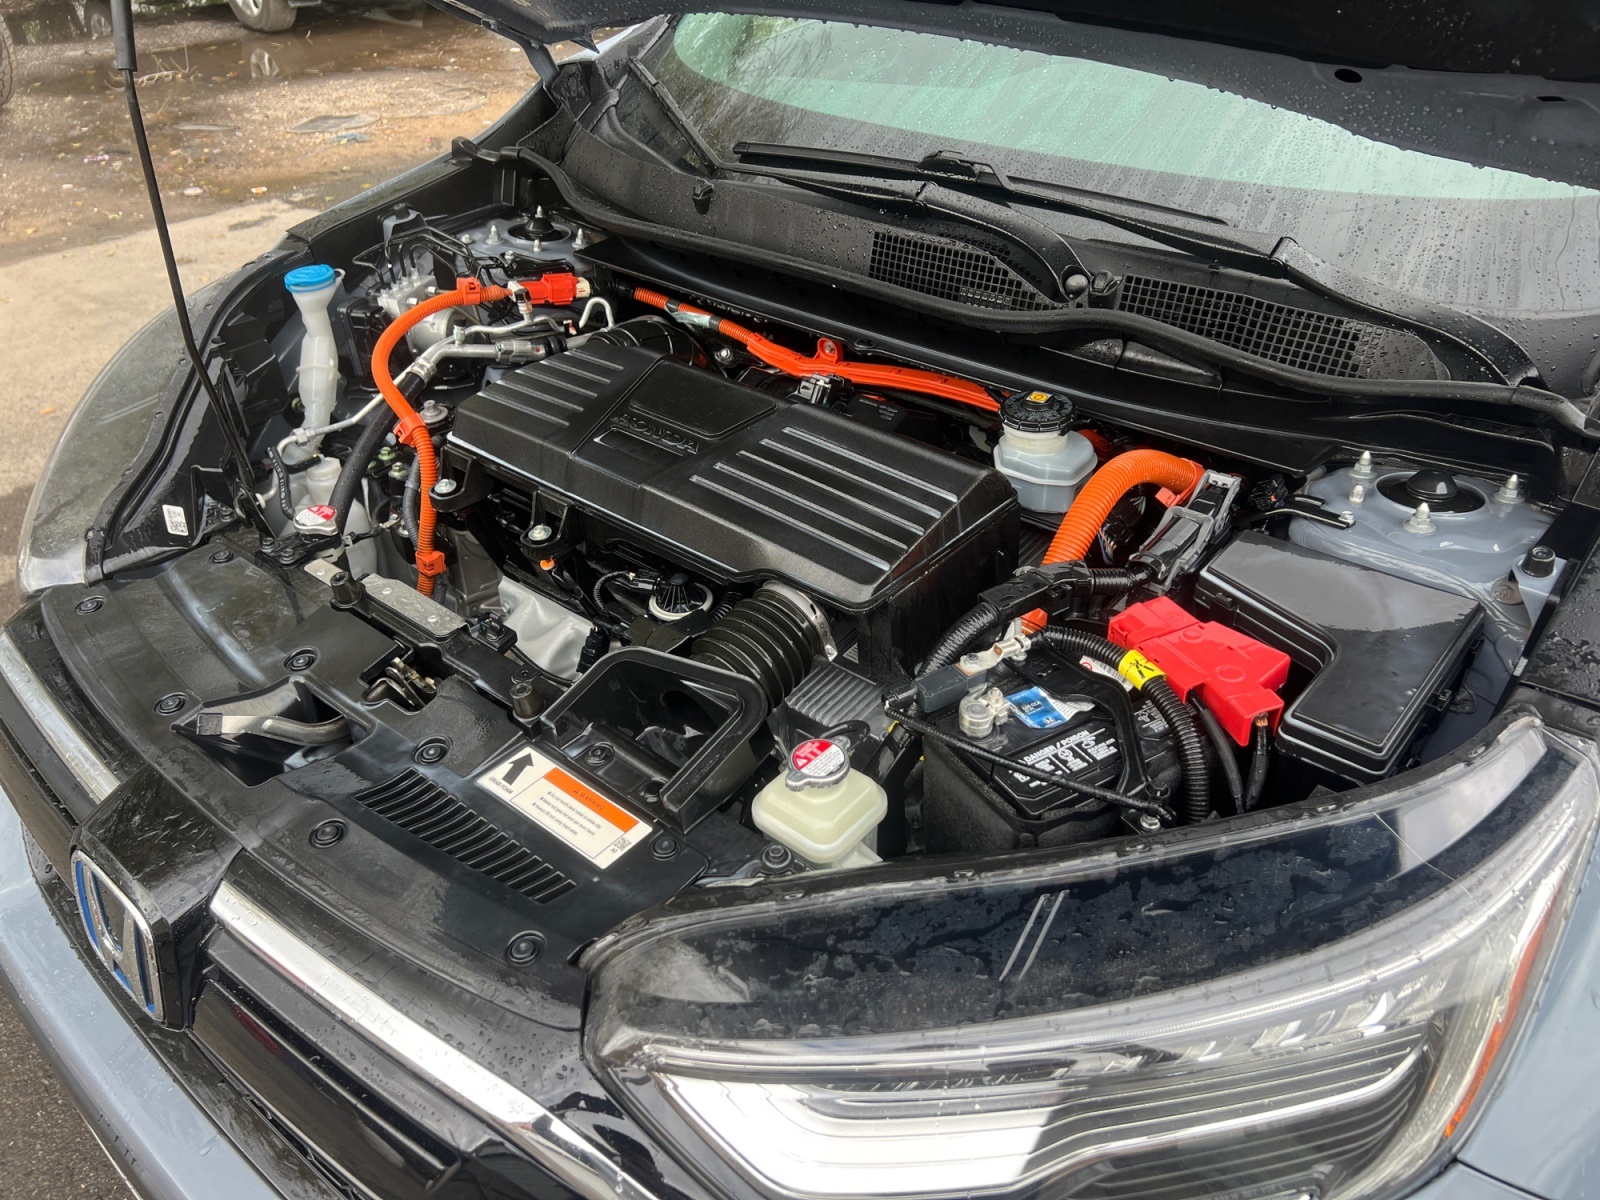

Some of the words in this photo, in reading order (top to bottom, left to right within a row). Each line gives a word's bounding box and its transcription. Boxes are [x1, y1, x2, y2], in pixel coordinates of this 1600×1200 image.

[610, 413, 699, 455] HONDA
[1023, 745, 1057, 762] DANGER
[1060, 729, 1091, 745] POISON
[488, 776, 502, 788] GRAB
[501, 784, 514, 795] FOAM
[580, 791, 605, 811] WARNING
